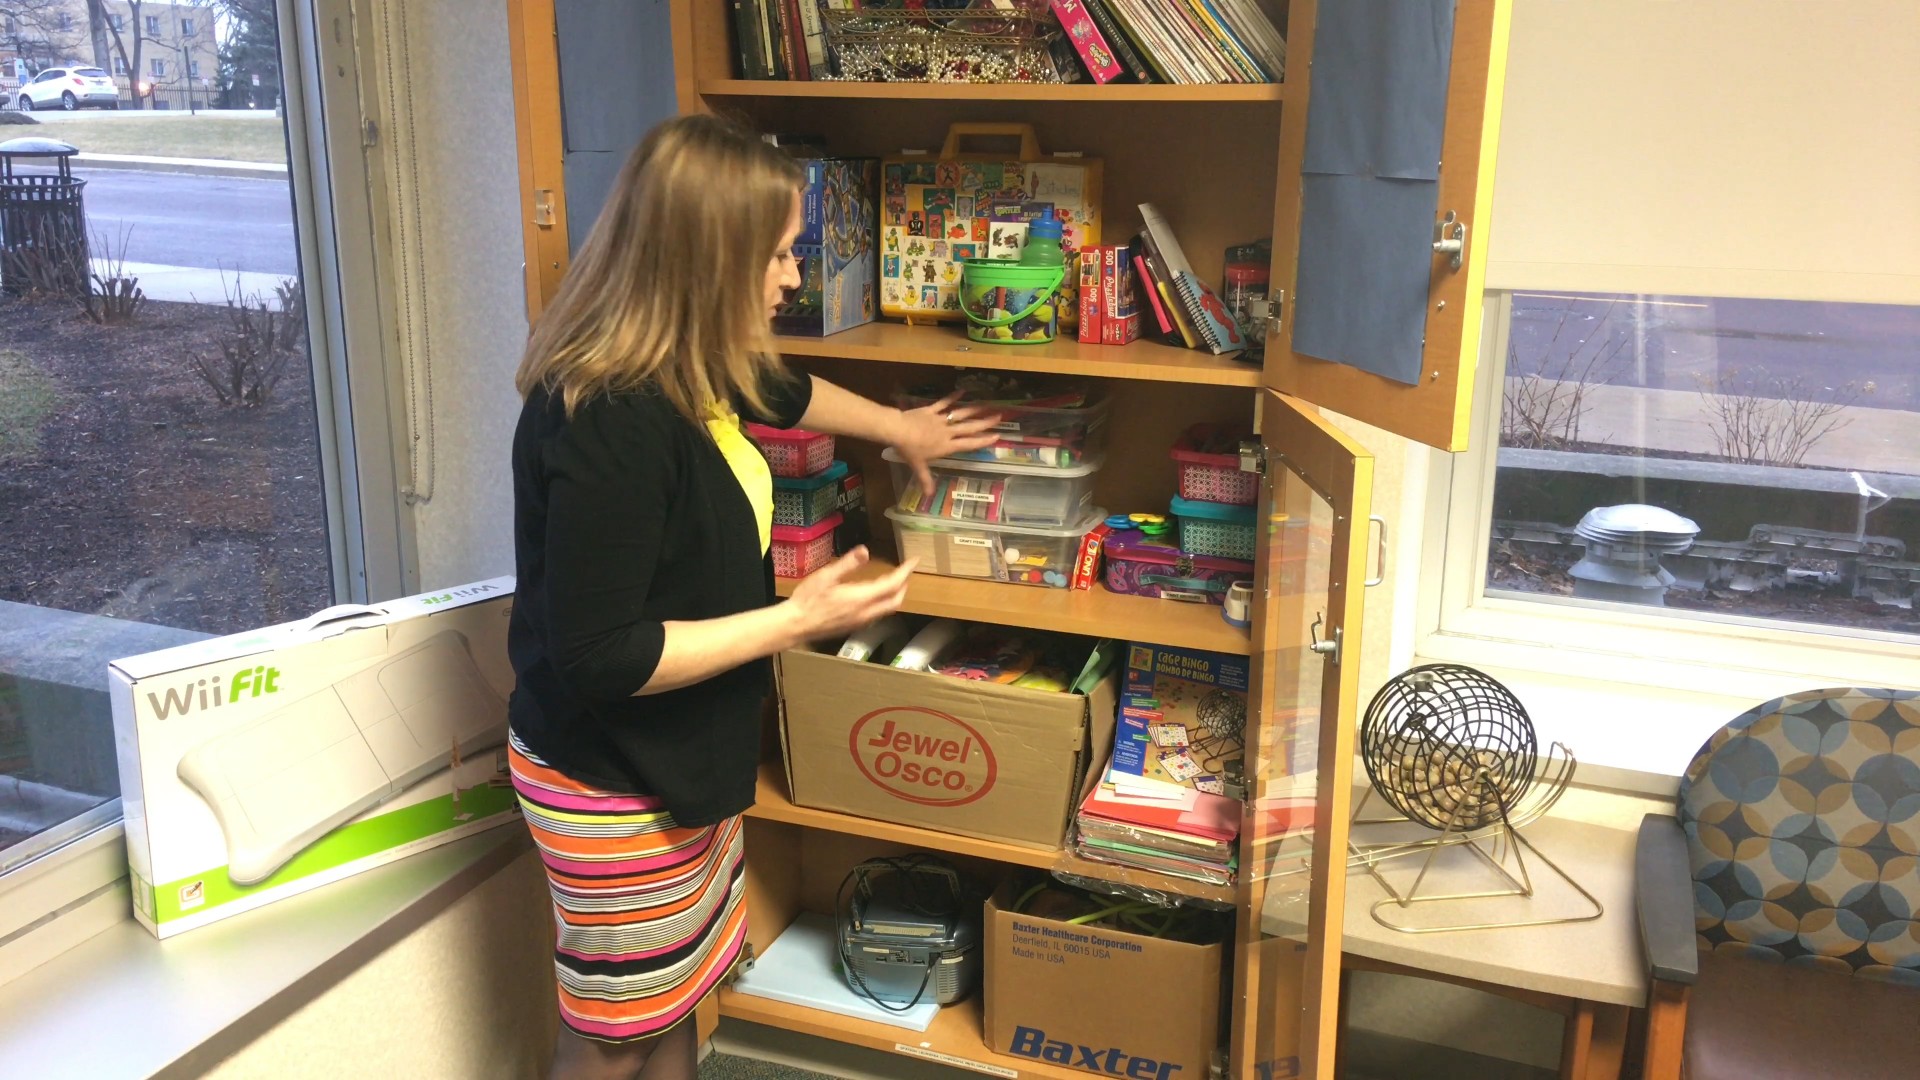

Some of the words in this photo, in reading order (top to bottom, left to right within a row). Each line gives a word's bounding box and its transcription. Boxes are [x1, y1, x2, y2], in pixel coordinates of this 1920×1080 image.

[1105, 250, 1114, 266] 500
[1089, 288, 1098, 303] 500
[1081, 555, 1094, 577] UNO
[147, 676, 222, 721] Wii
[229, 665, 280, 704] Fit
[868, 719, 972, 764] Jewel
[874, 751, 966, 791] Osco
[1012, 921, 1040, 935] Baxter
[1042, 926, 1089, 944] Healthcare
[1090, 934, 1143, 953] Corporation
[1012, 933, 1051, 950] Deerfield,
[1053, 941, 1062, 951] IL
[1063, 943, 1090, 957] 60015
[1092, 948, 1111, 960] USA
[1012, 946, 1035, 959] Made
[1036, 950, 1045, 961] in
[1046, 952, 1065, 965] USA
[1009, 1025, 1183, 1080] Baxter
